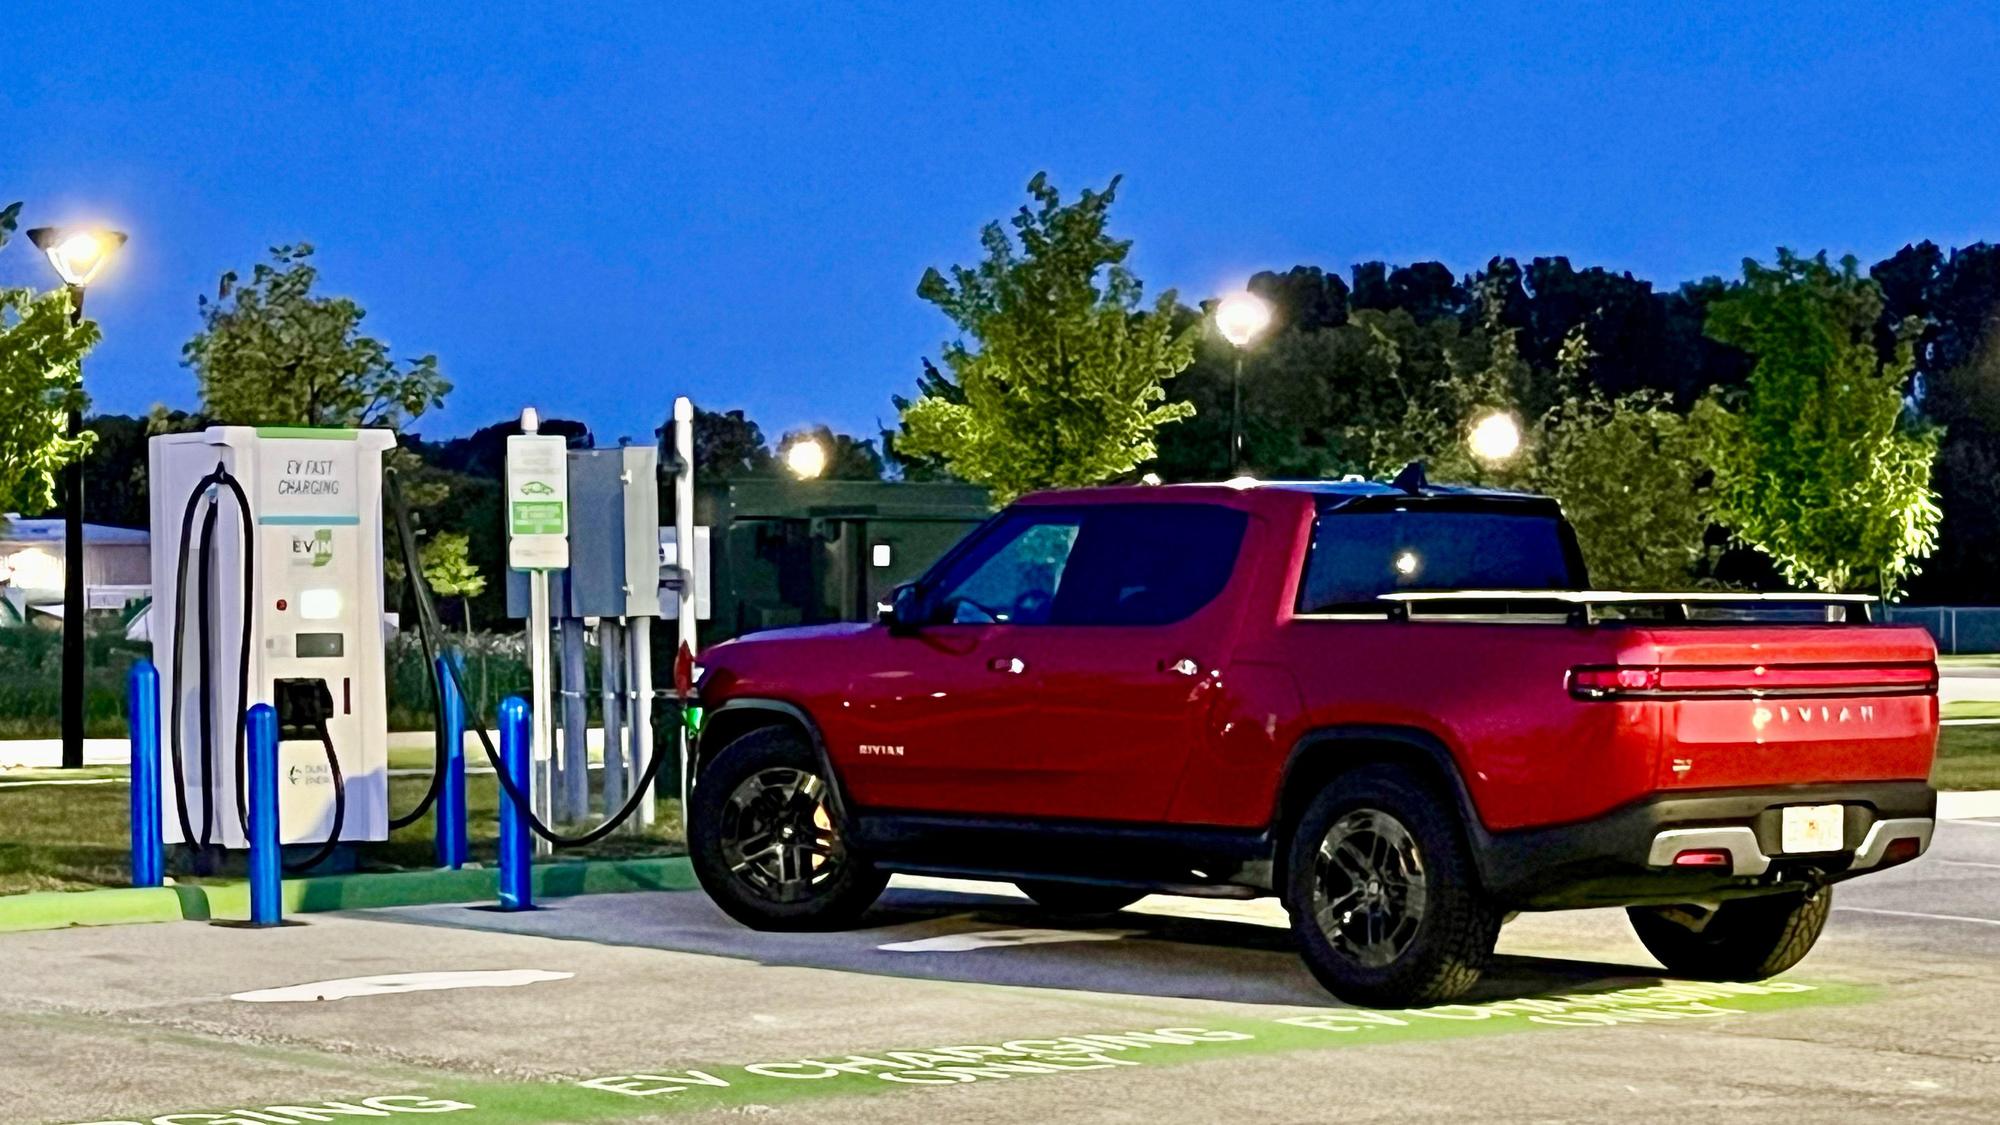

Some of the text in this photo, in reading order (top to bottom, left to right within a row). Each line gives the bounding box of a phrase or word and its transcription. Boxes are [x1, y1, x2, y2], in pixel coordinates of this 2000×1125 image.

[287, 459, 333, 476] EV FAST
[278, 479, 340, 495] CHARGING
[859, 744, 904, 756] RIVIAN
[579, 1026, 1255, 1097] EV CHARGING
[877, 1051, 1142, 1085] ONLY
[62, 1095, 476, 1125] GING
